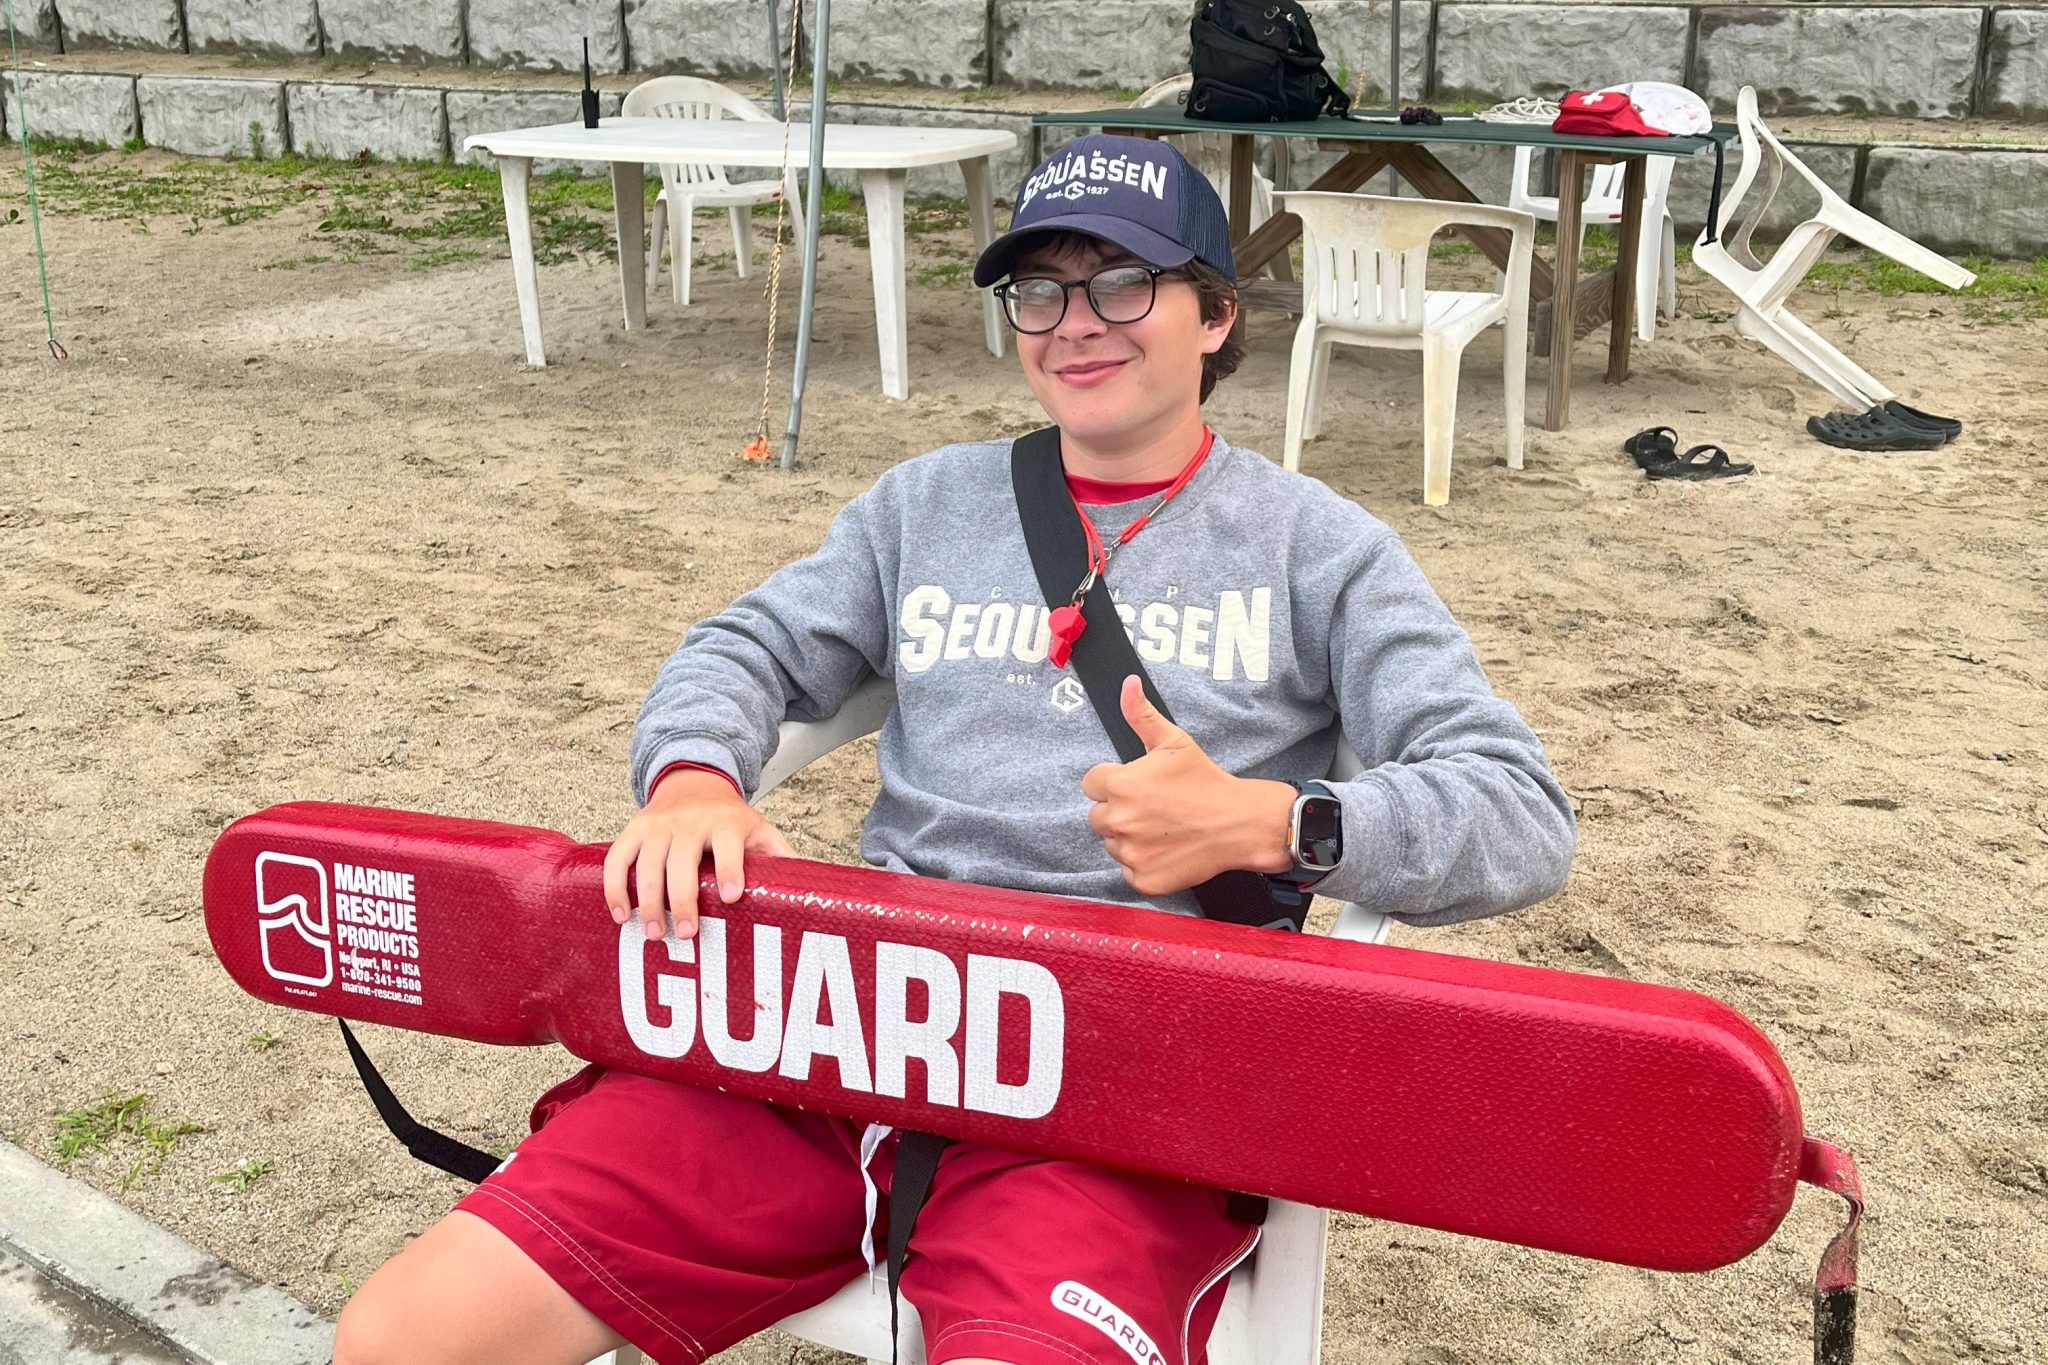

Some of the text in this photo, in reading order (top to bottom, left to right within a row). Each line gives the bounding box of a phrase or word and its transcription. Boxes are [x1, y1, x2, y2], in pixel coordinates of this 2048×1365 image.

[1086, 186, 1109, 195] 1927
[899, 585, 1271, 682] SEQUSEN
[1006, 672, 1036, 686] est.
[333, 862, 416, 902] MARINE
[335, 892, 418, 933] RESCUE
[336, 923, 420, 958] PRODUCTS
[340, 966, 422, 992] 1-800-341-9500
[381, 958, 392, 973] RI
[401, 962, 421, 977] USA
[341, 982, 423, 1005] marine-rescue.com
[618, 907, 1065, 1119] GUARD
[1062, 1289, 1149, 1357] GUARD
